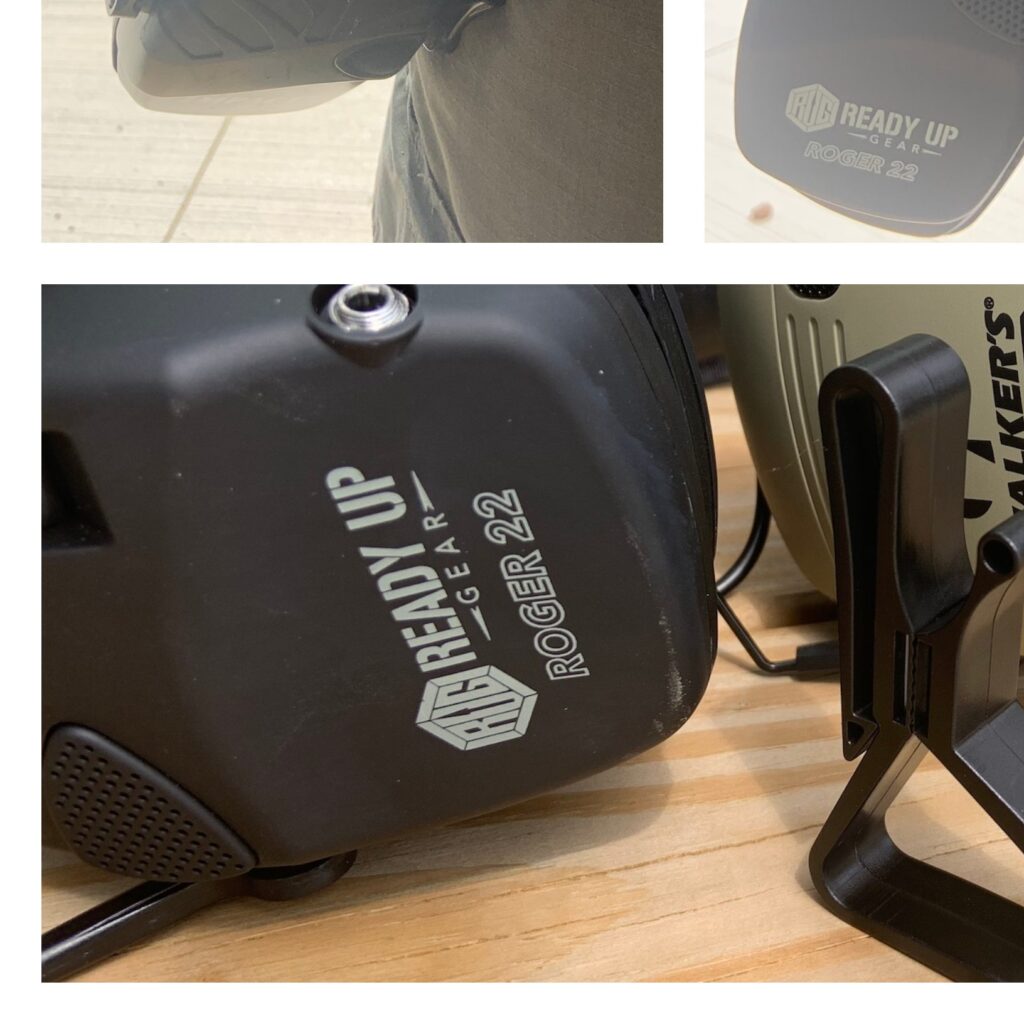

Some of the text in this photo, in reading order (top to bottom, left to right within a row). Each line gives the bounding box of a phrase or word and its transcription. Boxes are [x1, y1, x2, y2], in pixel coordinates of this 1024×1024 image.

[840, 102, 958, 148] READY UP
[869, 134, 920, 154] GEAR
[804, 141, 919, 182] ROGER 22
[326, 466, 477, 673] READY UP
[422, 513, 480, 604] GEAR
[473, 488, 590, 680] ROGER 22
